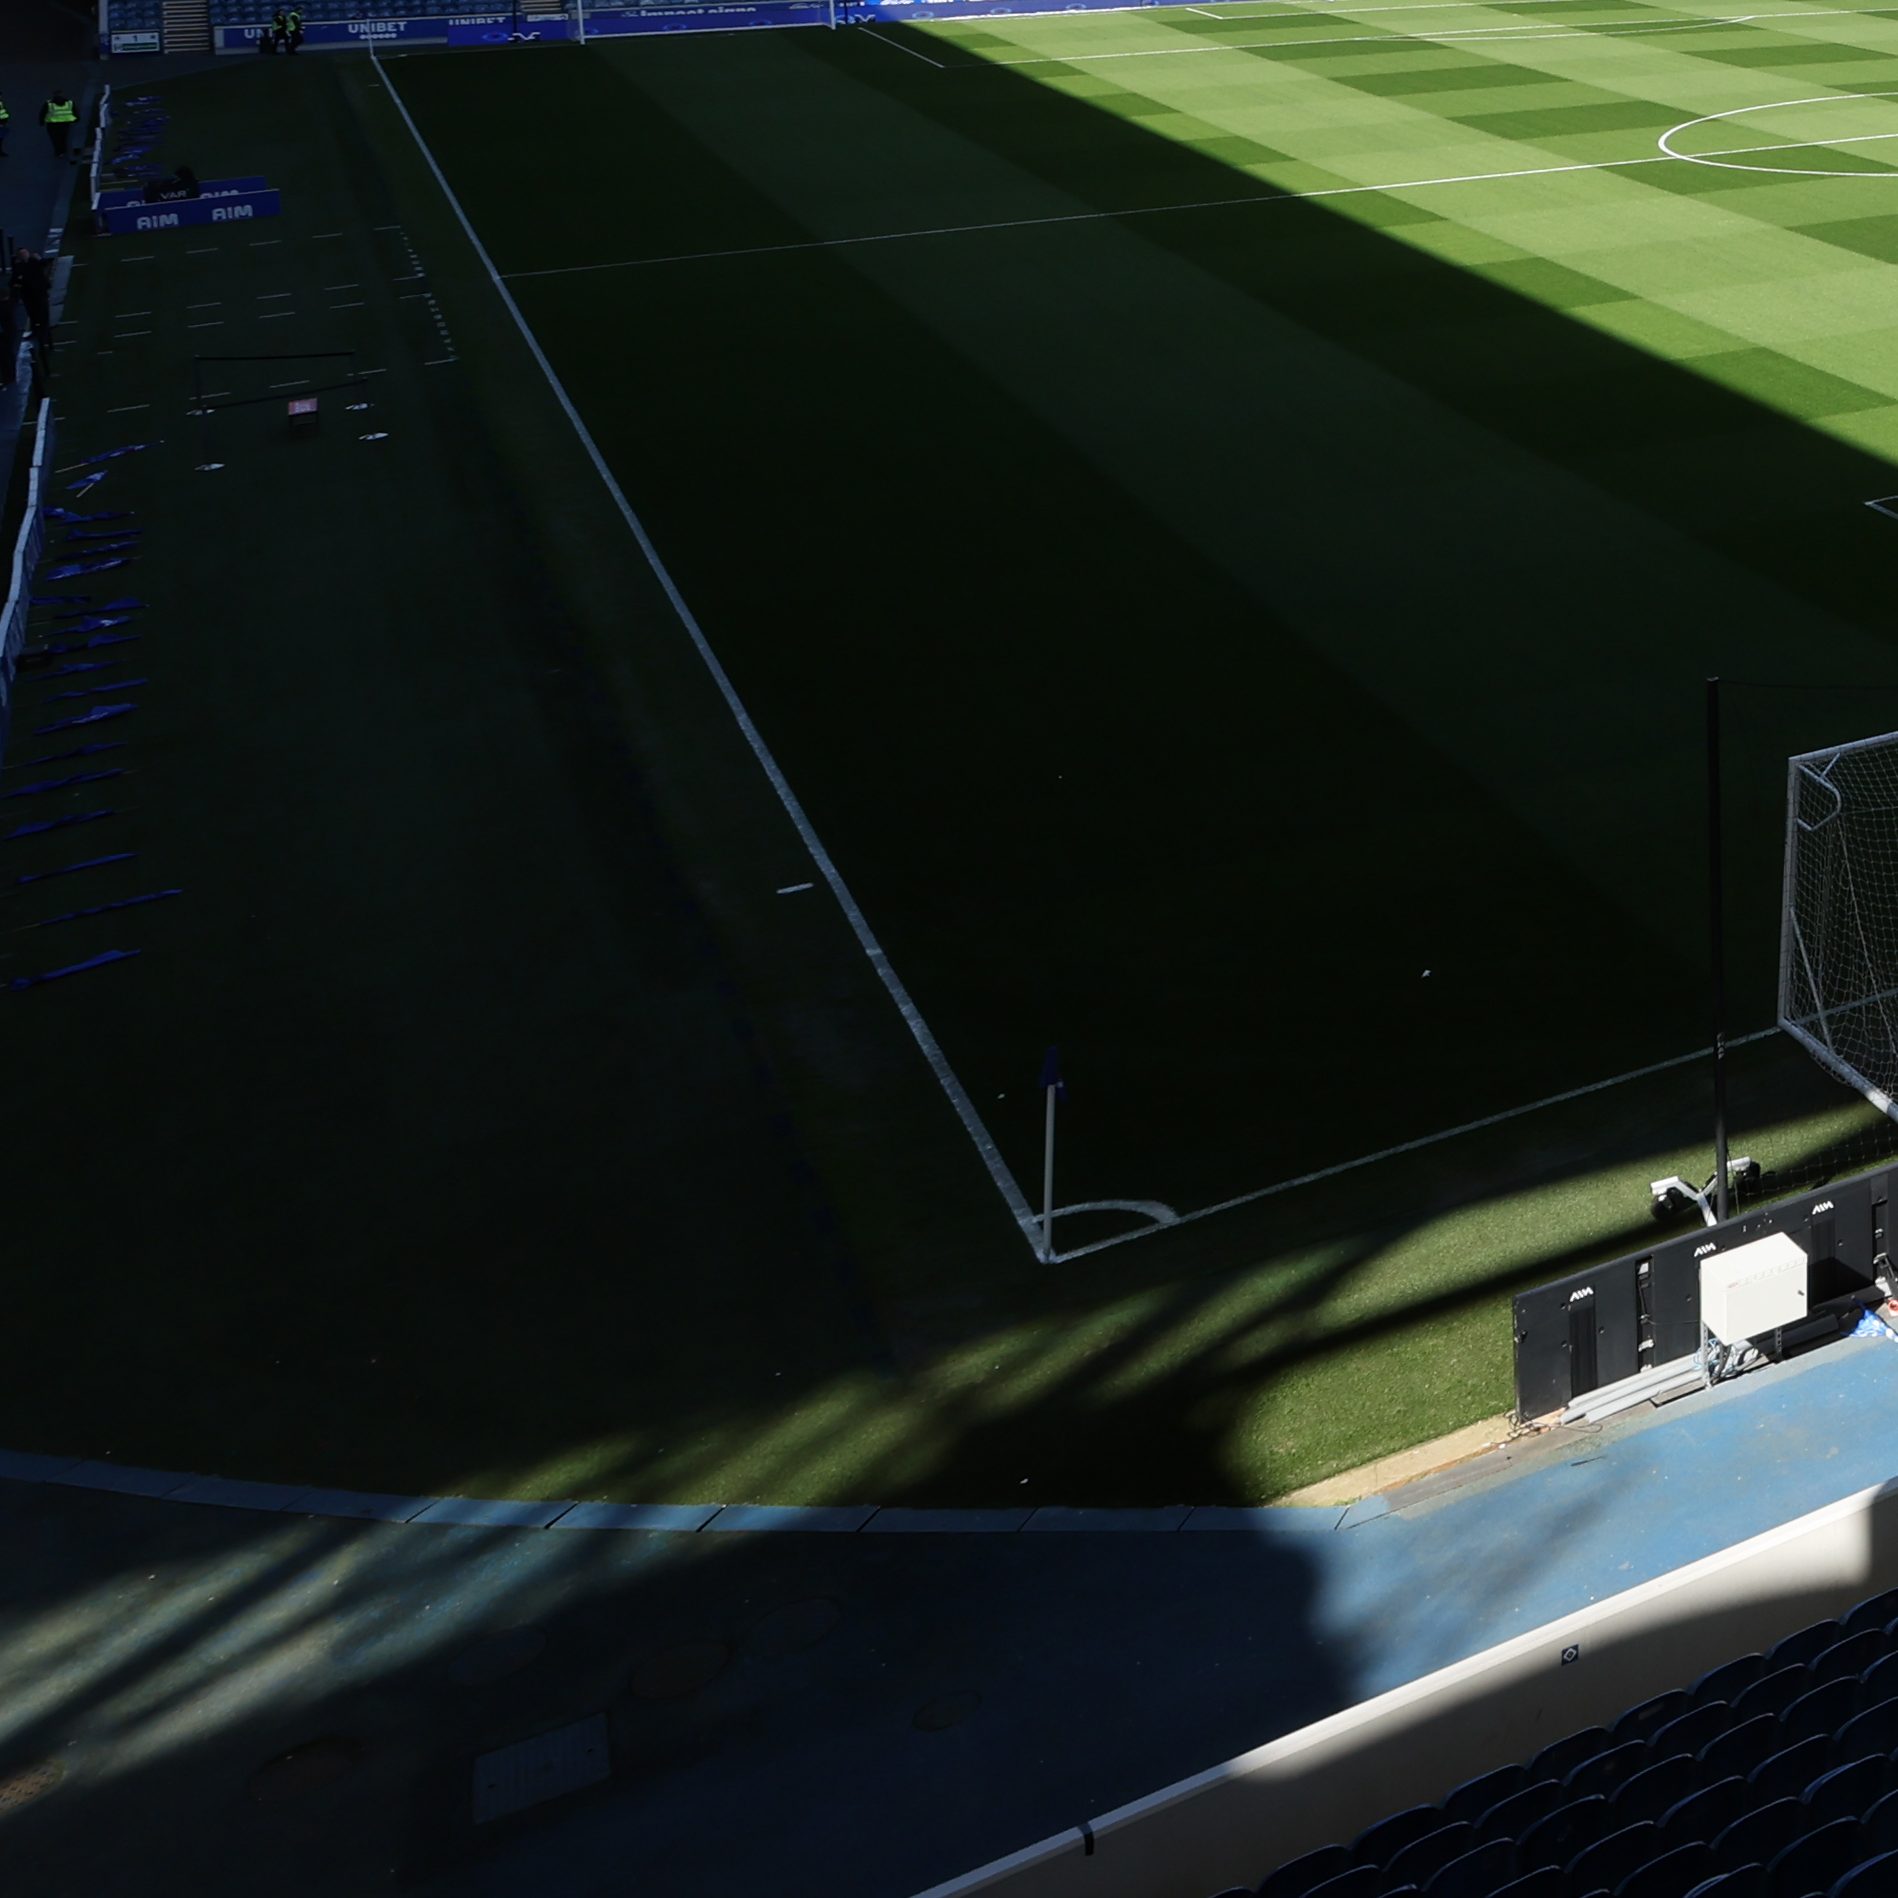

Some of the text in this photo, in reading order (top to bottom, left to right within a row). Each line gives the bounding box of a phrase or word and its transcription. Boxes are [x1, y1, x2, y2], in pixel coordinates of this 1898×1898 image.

[347, 20, 407, 35] UNIBET
[160, 190, 188, 200] VAR
[212, 204, 254, 222] AIM
[136, 213, 180, 231] AIM
